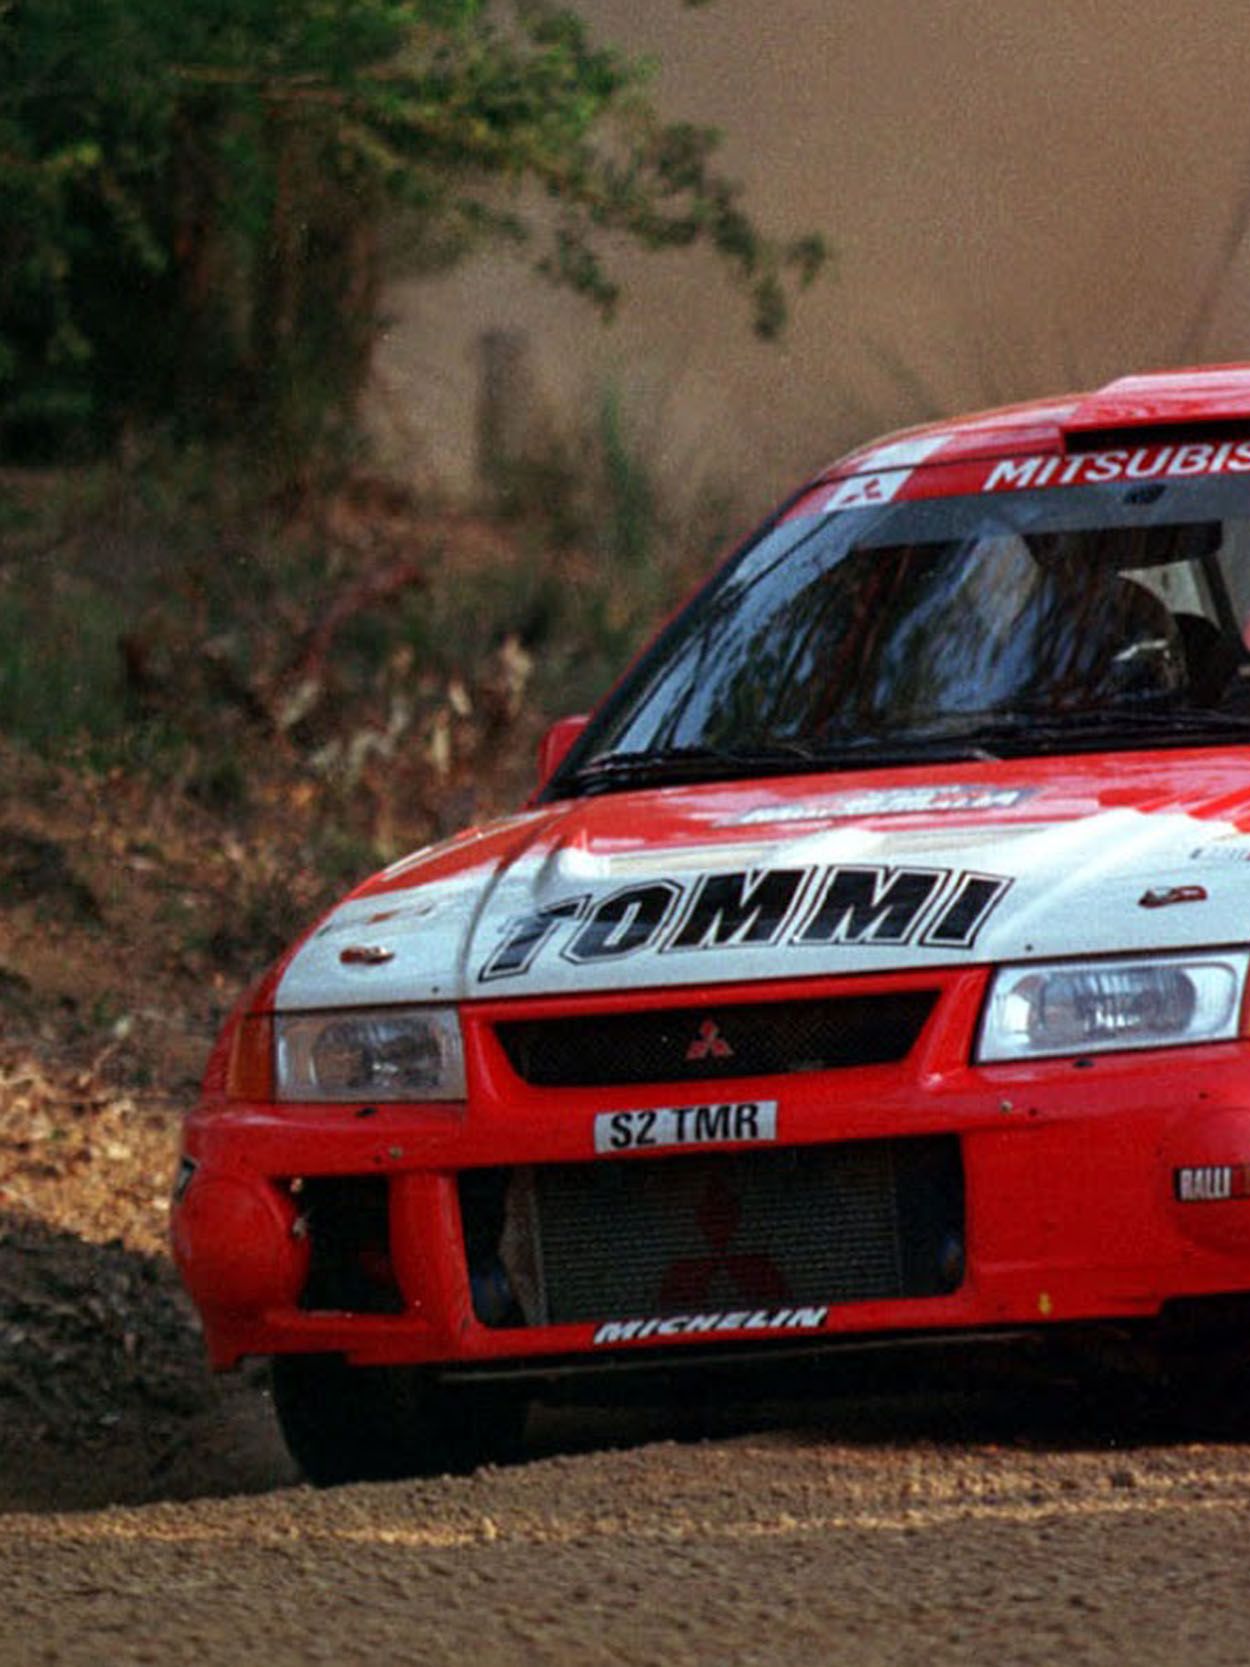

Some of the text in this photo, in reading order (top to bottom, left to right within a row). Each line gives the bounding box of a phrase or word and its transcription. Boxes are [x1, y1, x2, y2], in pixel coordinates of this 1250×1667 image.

[478, 864, 1016, 982] TOMMI
[610, 1104, 758, 1149] S2 TMR
[594, 1306, 828, 1344] MICHELIN
